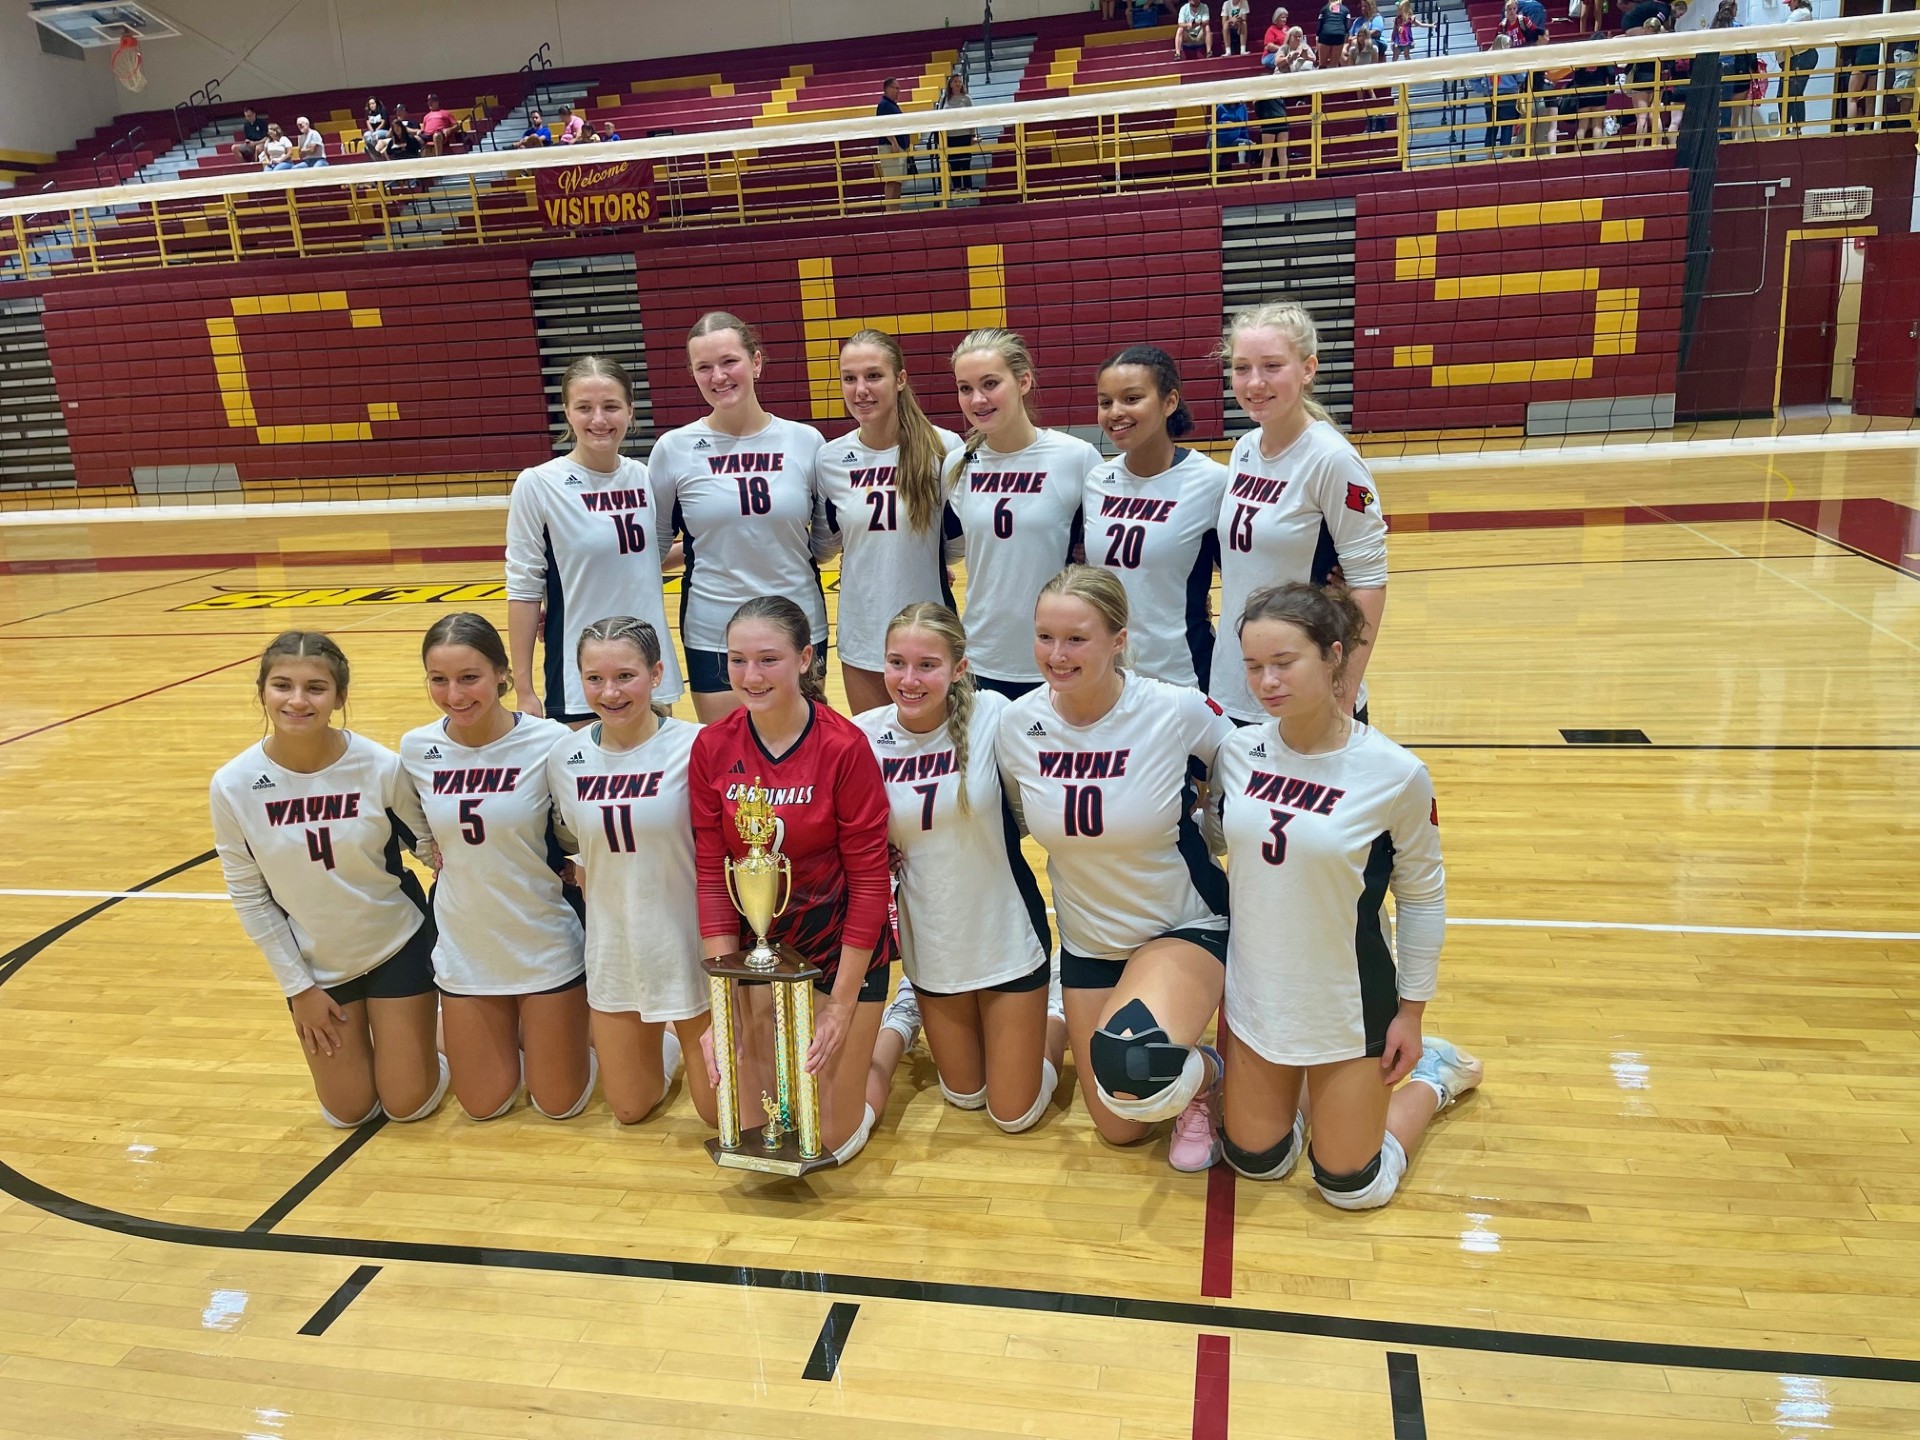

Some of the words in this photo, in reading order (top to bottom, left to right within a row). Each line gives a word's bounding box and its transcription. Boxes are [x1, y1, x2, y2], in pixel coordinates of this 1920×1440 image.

[558, 161, 629, 196] Welcome
[545, 190, 651, 226] VISITORS
[707, 452, 785, 475] WAYNE
[970, 472, 1048, 493] WAYNE
[580, 488, 648, 512] WAYNE
[734, 476, 773, 516] 18
[1229, 472, 1289, 504] WAYNE
[866, 490, 897, 531] 21
[993, 497, 1013, 540] 6
[1099, 494, 1178, 523] WAYNE
[1229, 502, 1261, 553] 13
[610, 512, 646, 555] 16
[1104, 522, 1146, 569] 20
[567, 757, 585, 765] adidas
[1038, 748, 1131, 779] WAYNE
[252, 782, 276, 790] adidas
[432, 767, 521, 795] WAYNE
[576, 771, 665, 802] WAYNE
[1244, 769, 1346, 816] WAYNE
[265, 792, 361, 827] WAYNE
[459, 798, 486, 846] 5
[912, 782, 939, 831] 7
[1062, 784, 1104, 837] 10
[598, 804, 636, 853] 11
[1262, 808, 1296, 866] 3
[305, 826, 335, 871] 4
